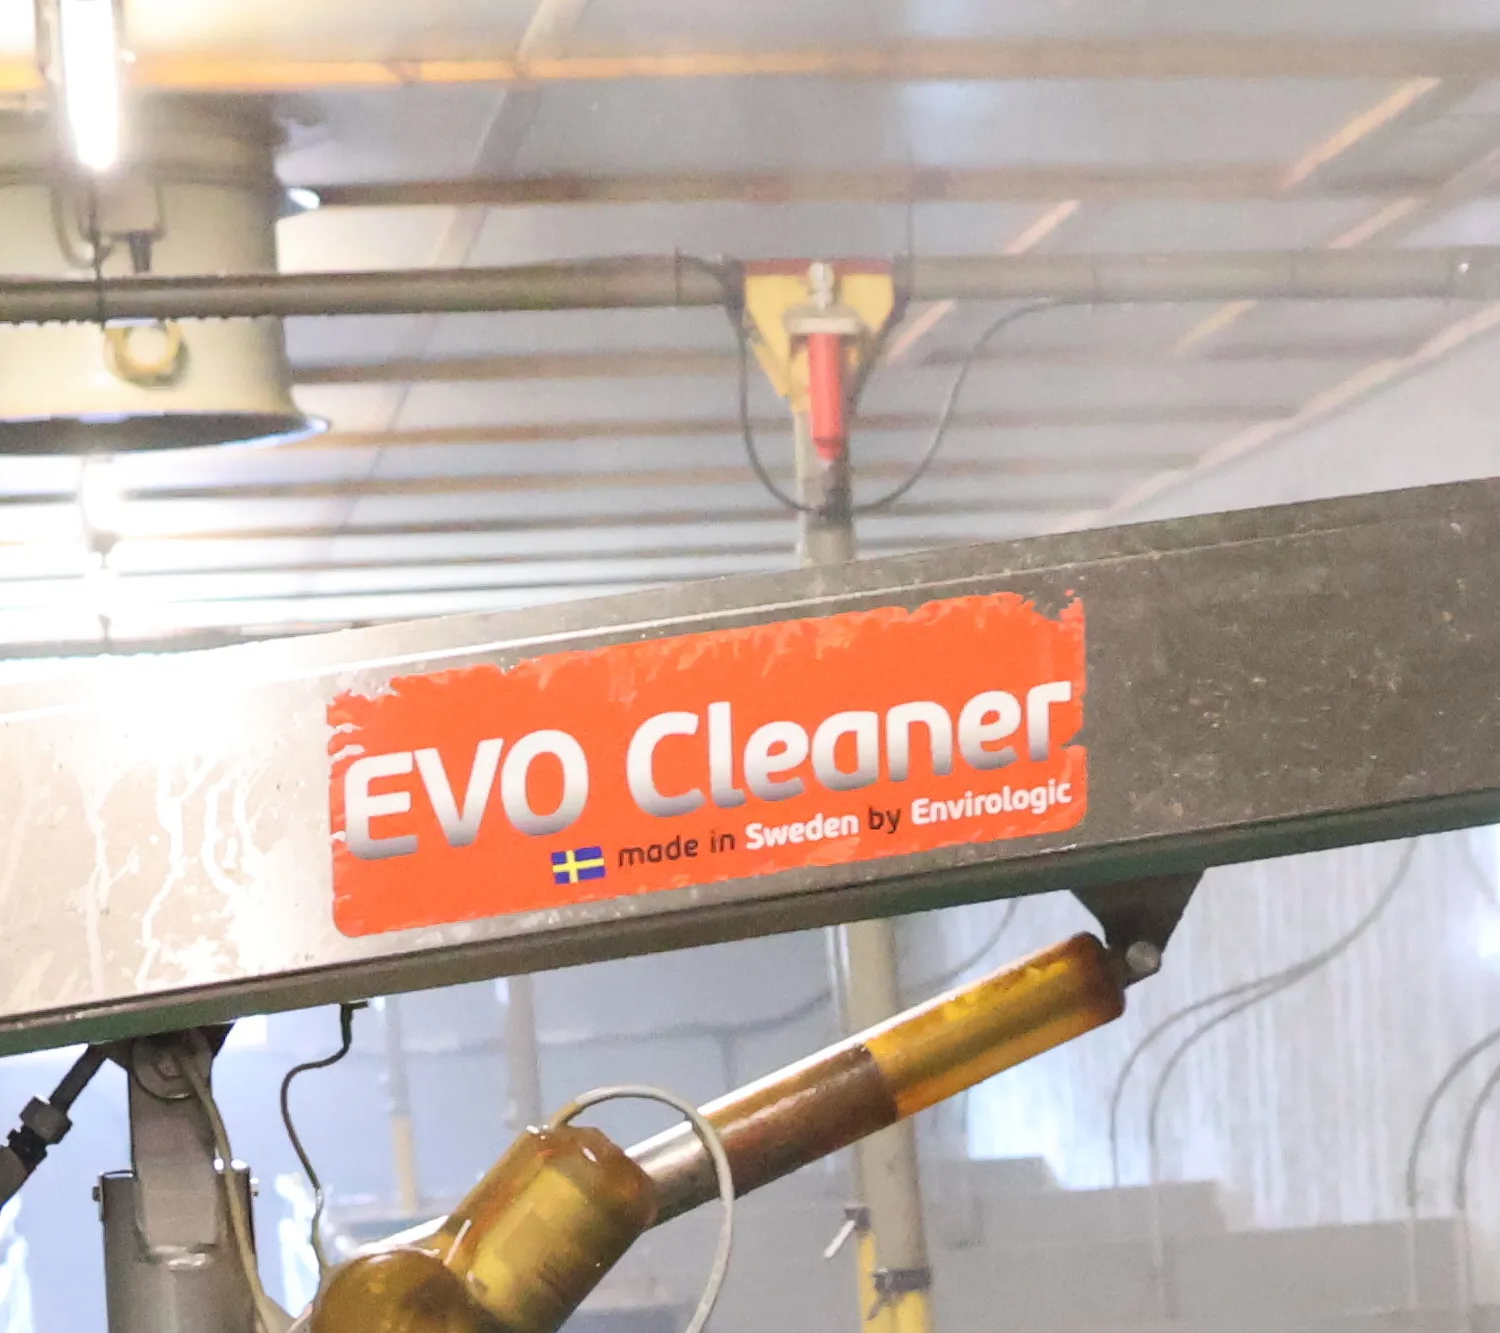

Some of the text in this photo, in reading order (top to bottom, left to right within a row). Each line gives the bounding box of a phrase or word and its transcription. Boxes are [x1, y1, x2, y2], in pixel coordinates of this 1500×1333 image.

[344, 681, 1072, 860] EVO Cleaner
[617, 778, 1073, 869] made in Sweden by Envirologic
